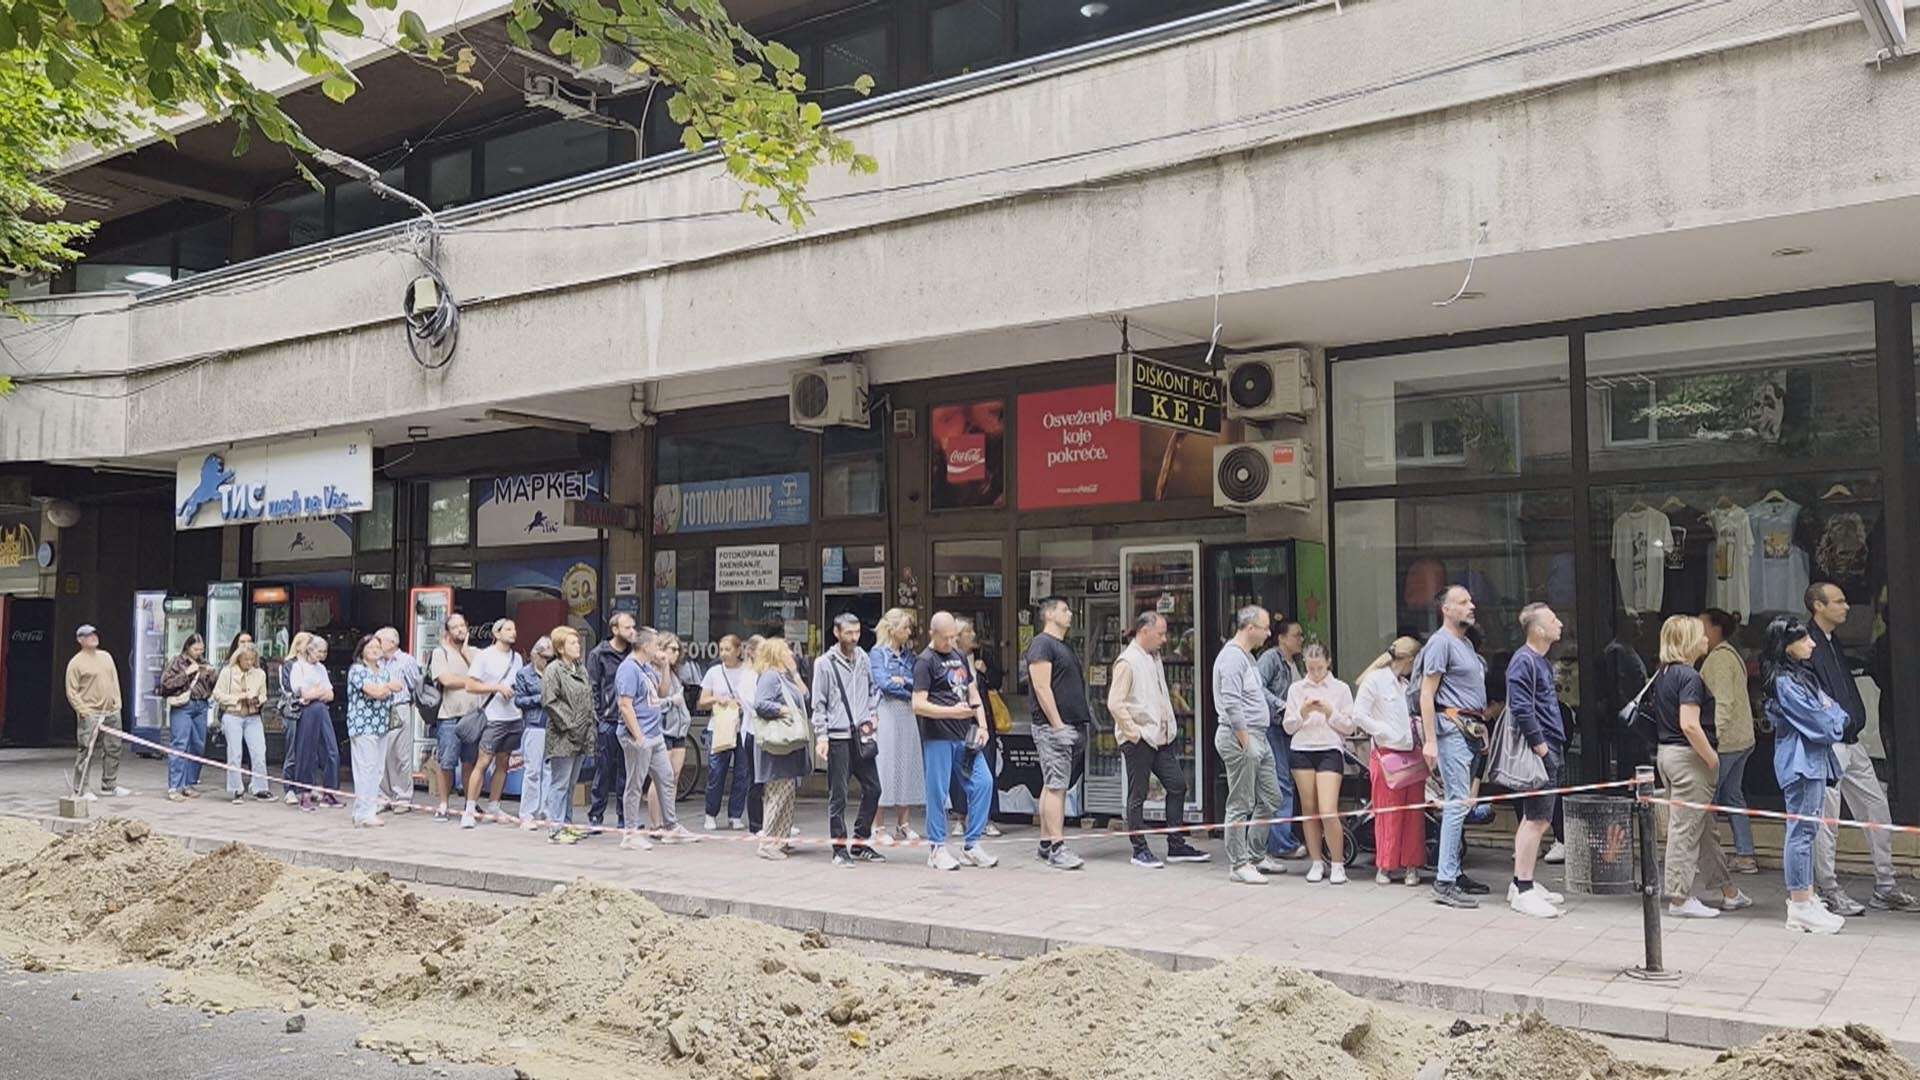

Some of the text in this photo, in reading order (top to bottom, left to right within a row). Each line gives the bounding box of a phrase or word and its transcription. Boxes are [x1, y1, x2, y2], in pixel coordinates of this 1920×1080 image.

[1136, 362, 1219, 401] DISKONT PIĆA
[1042, 406, 1113, 430] Osveženje
[1150, 393, 1206, 427] KEJ
[1062, 427, 1093, 447] koje
[1047, 445, 1109, 468] pokreće.
[682, 485, 773, 527] FOTOKOPIRANJE
[1093, 579, 1119, 592] ultra
